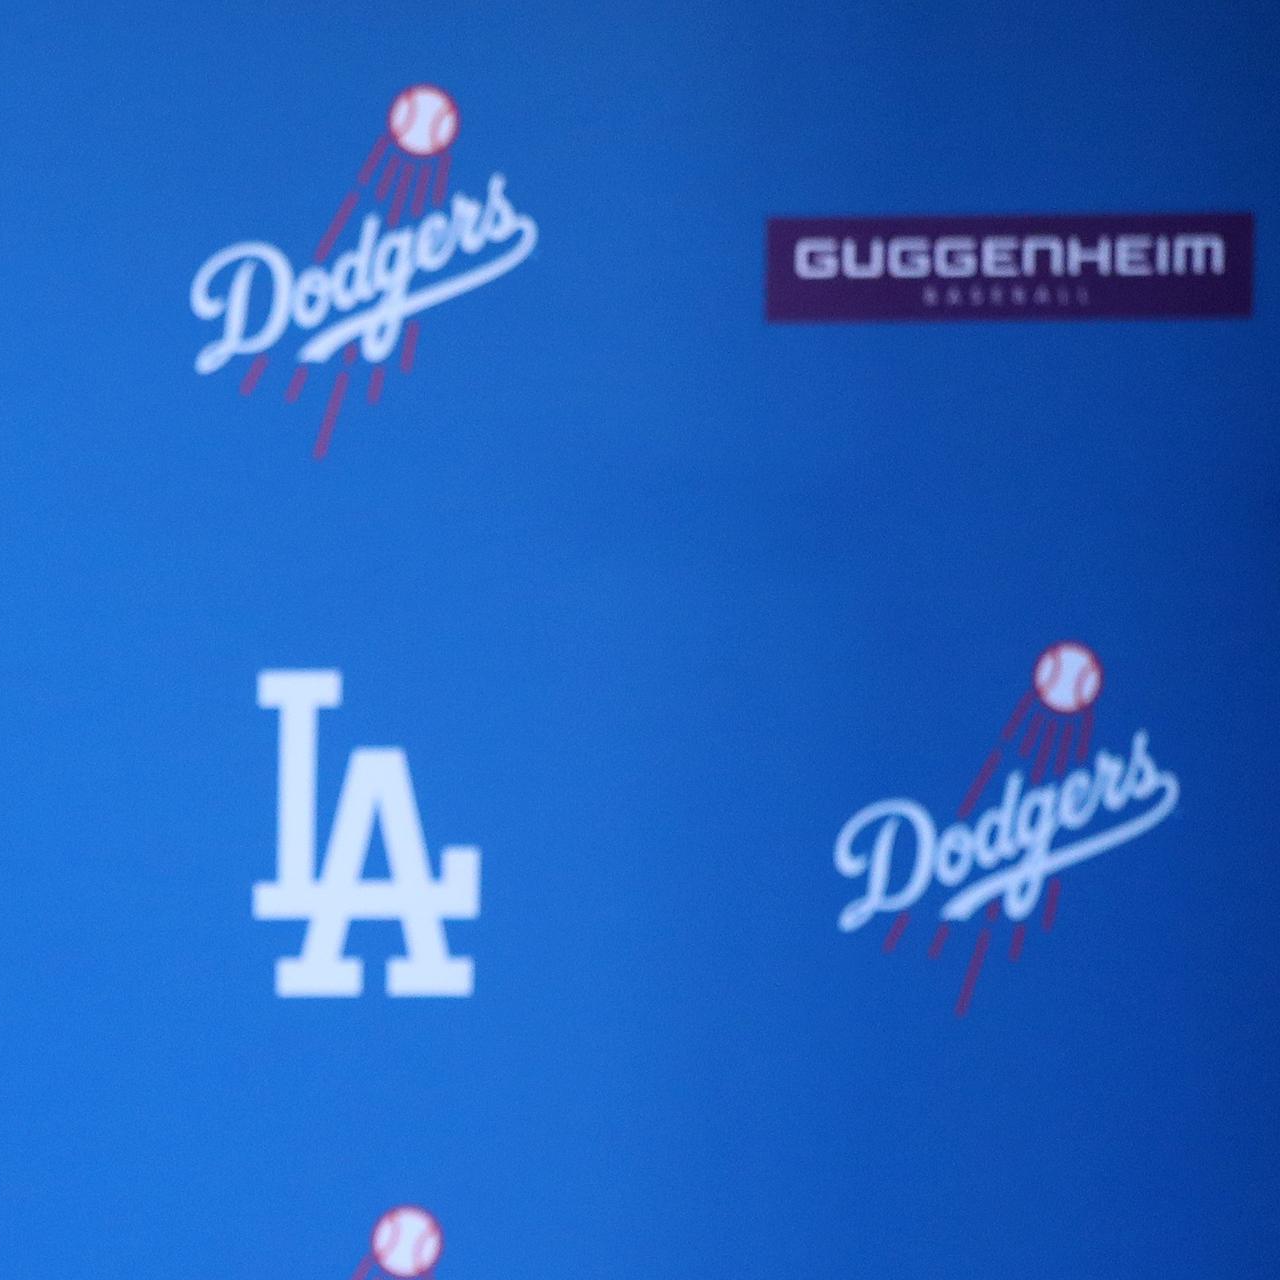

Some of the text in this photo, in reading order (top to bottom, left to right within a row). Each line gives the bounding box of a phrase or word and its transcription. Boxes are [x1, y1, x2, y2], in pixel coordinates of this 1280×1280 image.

[189, 171, 538, 376] Dodgers
[793, 234, 1225, 280] GUGGENHEIM
[252, 669, 481, 998] LA
[832, 732, 1180, 932] Dodgers
